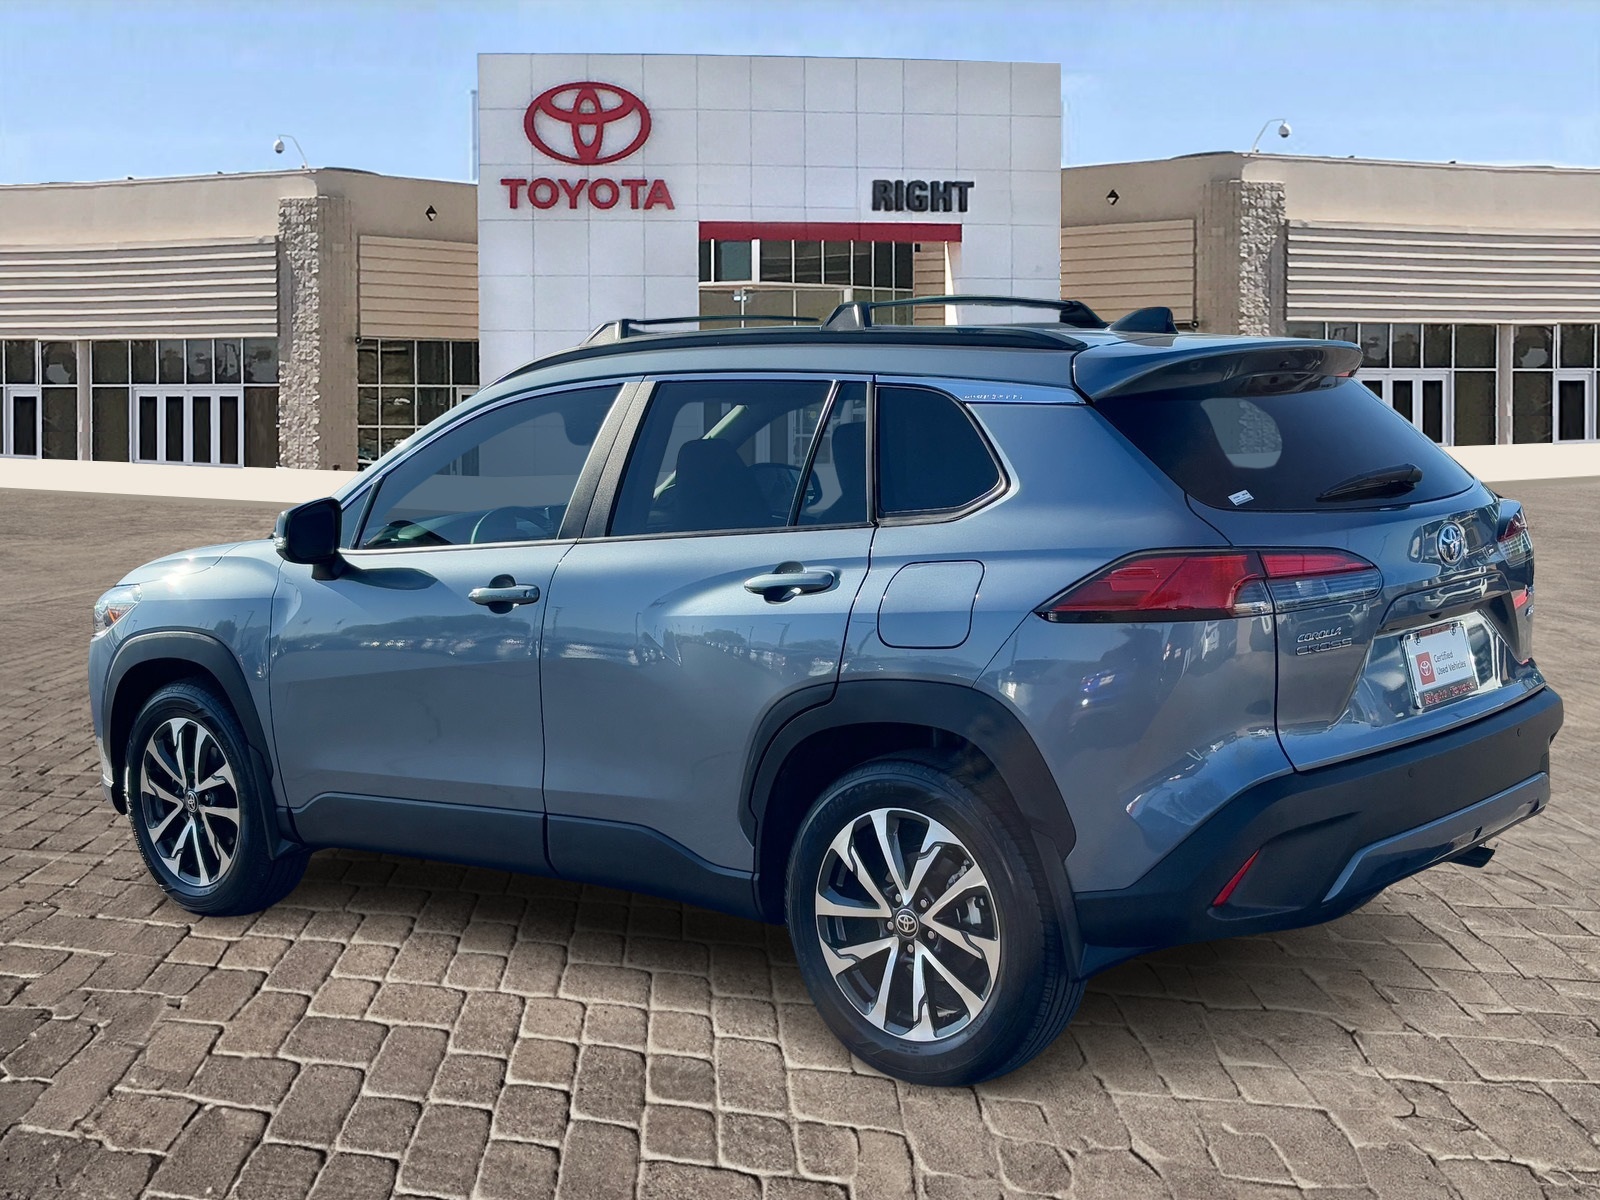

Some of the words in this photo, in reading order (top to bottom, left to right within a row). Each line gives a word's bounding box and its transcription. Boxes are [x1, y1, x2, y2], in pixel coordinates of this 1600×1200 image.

[500, 177, 675, 210] TOYOTA
[872, 179, 975, 213] RIGHT
[1297, 626, 1342, 643] COROLLA
[1296, 637, 1352, 656] CROSS
[1433, 650, 1454, 663] Certified
[1436, 664, 1449, 675] Used
[1448, 660, 1467, 671] Vehicles
